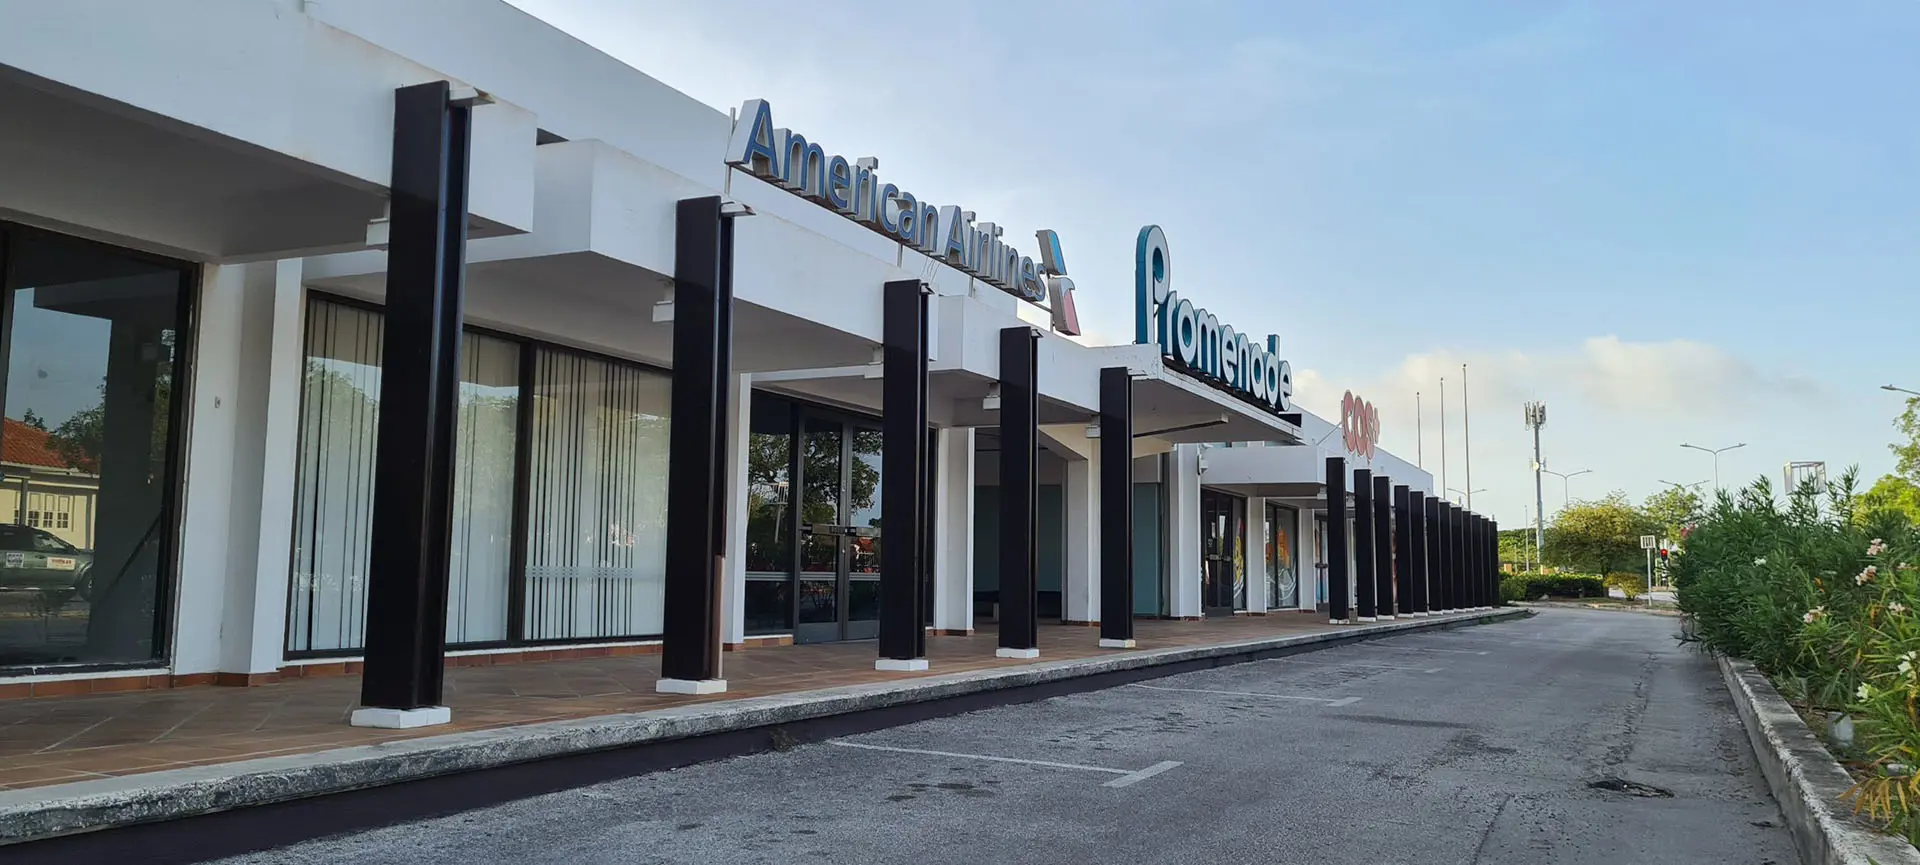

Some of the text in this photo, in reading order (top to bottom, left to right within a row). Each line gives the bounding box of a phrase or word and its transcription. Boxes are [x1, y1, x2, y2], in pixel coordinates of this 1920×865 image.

[729, 98, 1046, 302] American Airlines
[1135, 224, 1293, 412] Promenade
